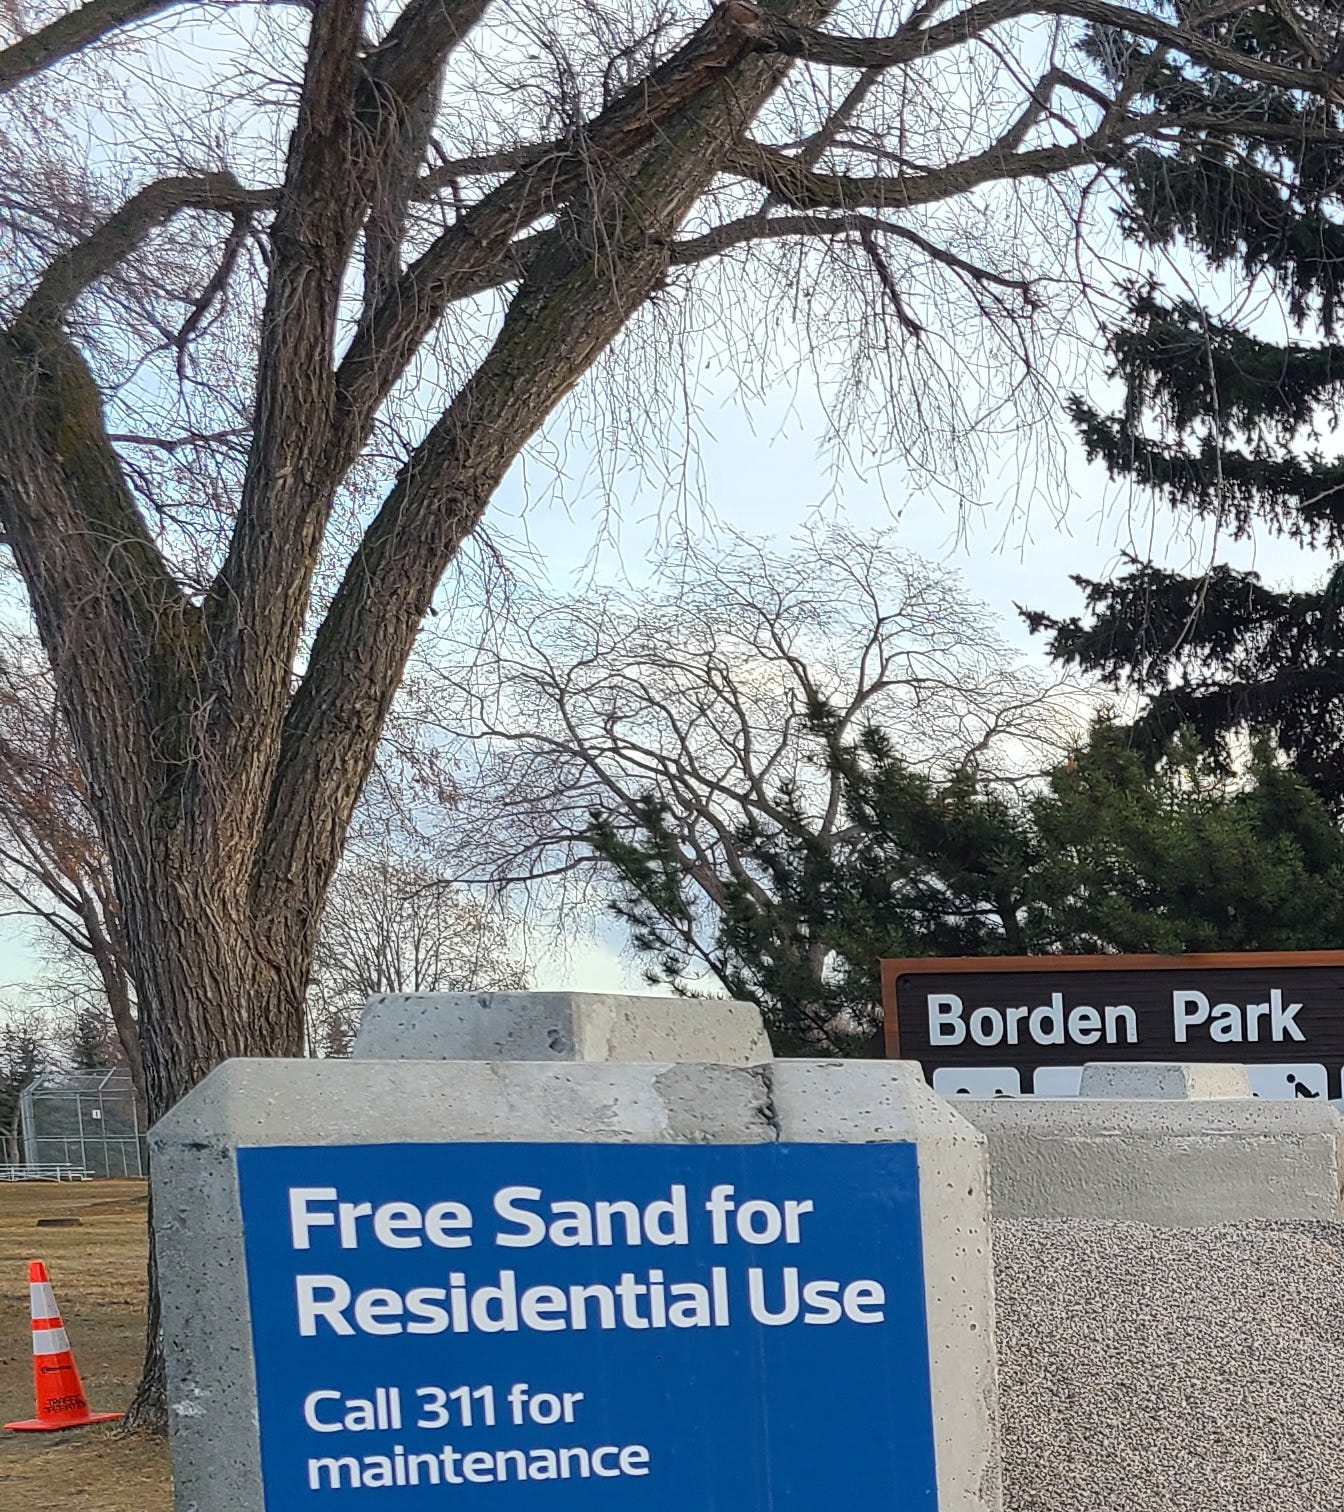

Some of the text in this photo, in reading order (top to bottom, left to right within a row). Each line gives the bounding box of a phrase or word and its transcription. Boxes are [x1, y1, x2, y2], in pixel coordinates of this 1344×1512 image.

[927, 988, 1307, 1046] Borden Park
[288, 1184, 814, 1250] Free Sand for
[295, 1266, 886, 1337] Residential Use
[303, 1383, 584, 1433] Call 311 for
[307, 1445, 650, 1490] maintenance
